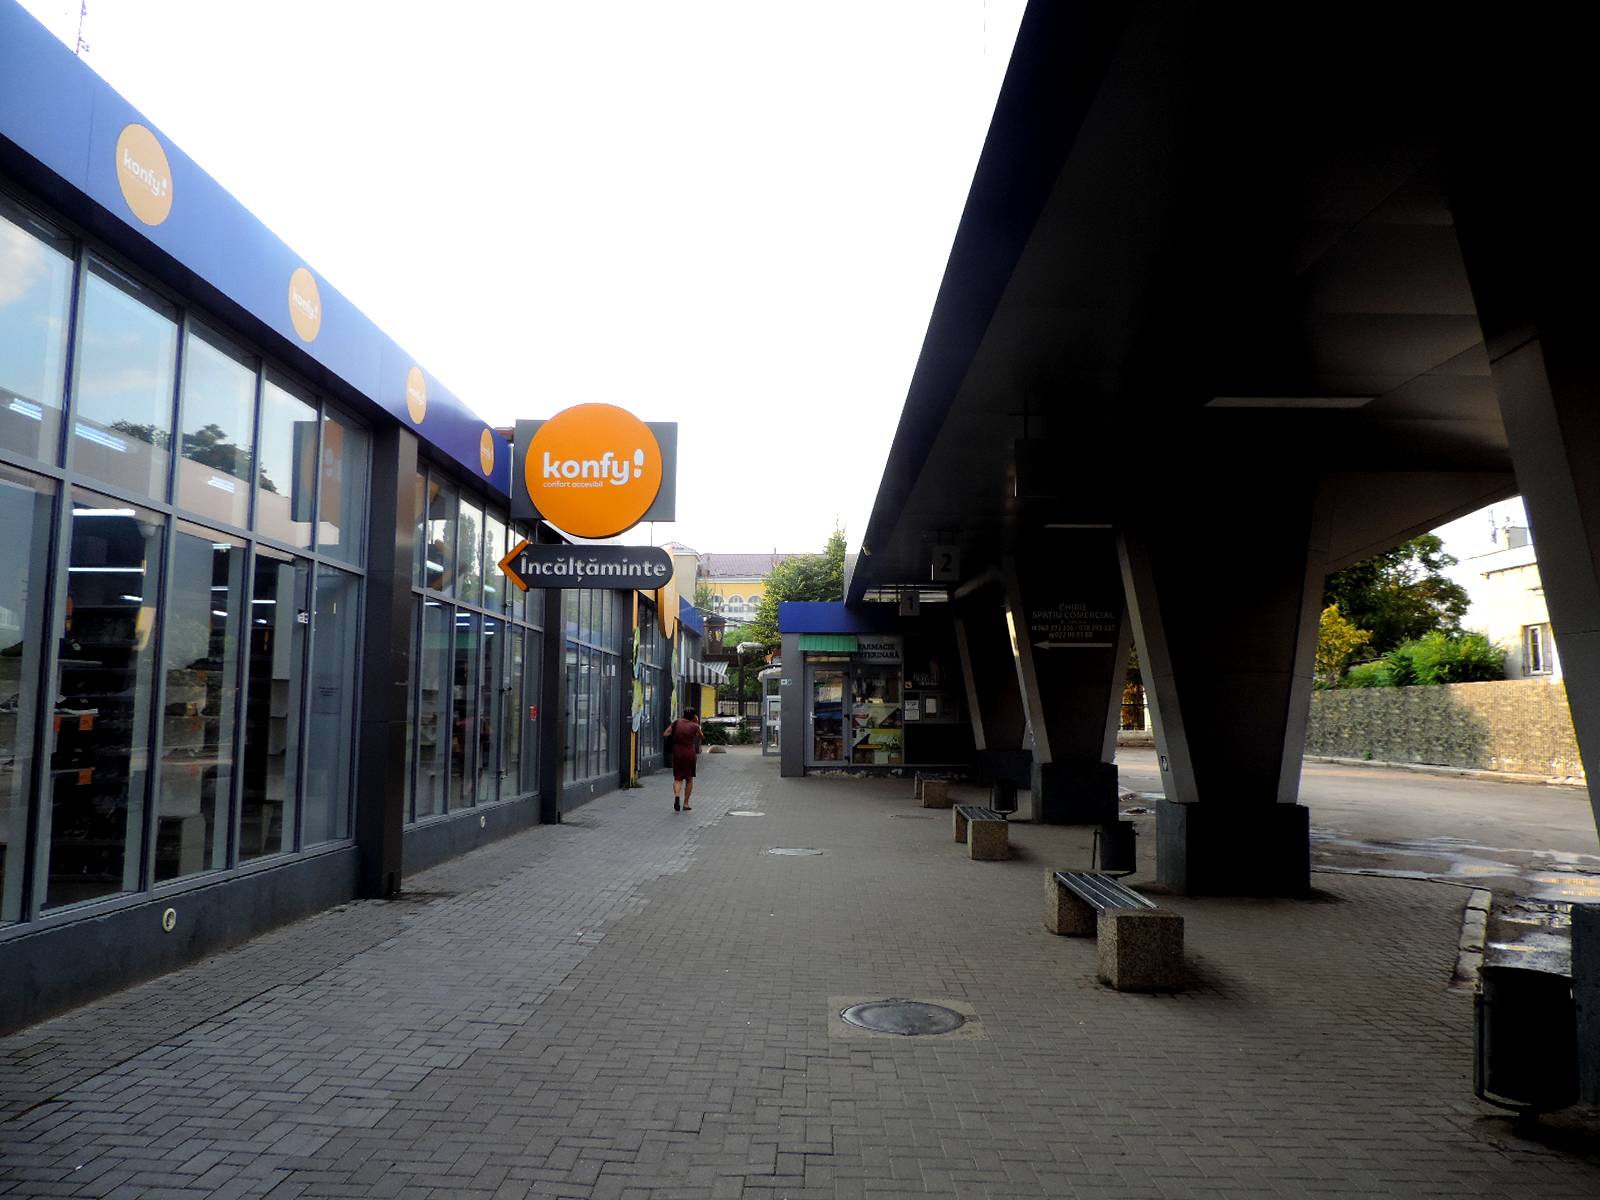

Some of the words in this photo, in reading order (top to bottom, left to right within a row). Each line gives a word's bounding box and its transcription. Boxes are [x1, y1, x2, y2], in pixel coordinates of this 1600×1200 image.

[520, 551, 667, 582] Încălțăminte
[941, 553, 952, 573] 2
[907, 595, 914, 610] 1
[1058, 603, 1088, 612] CHIRIE
[1064, 611, 1115, 619] COMERCIAL
